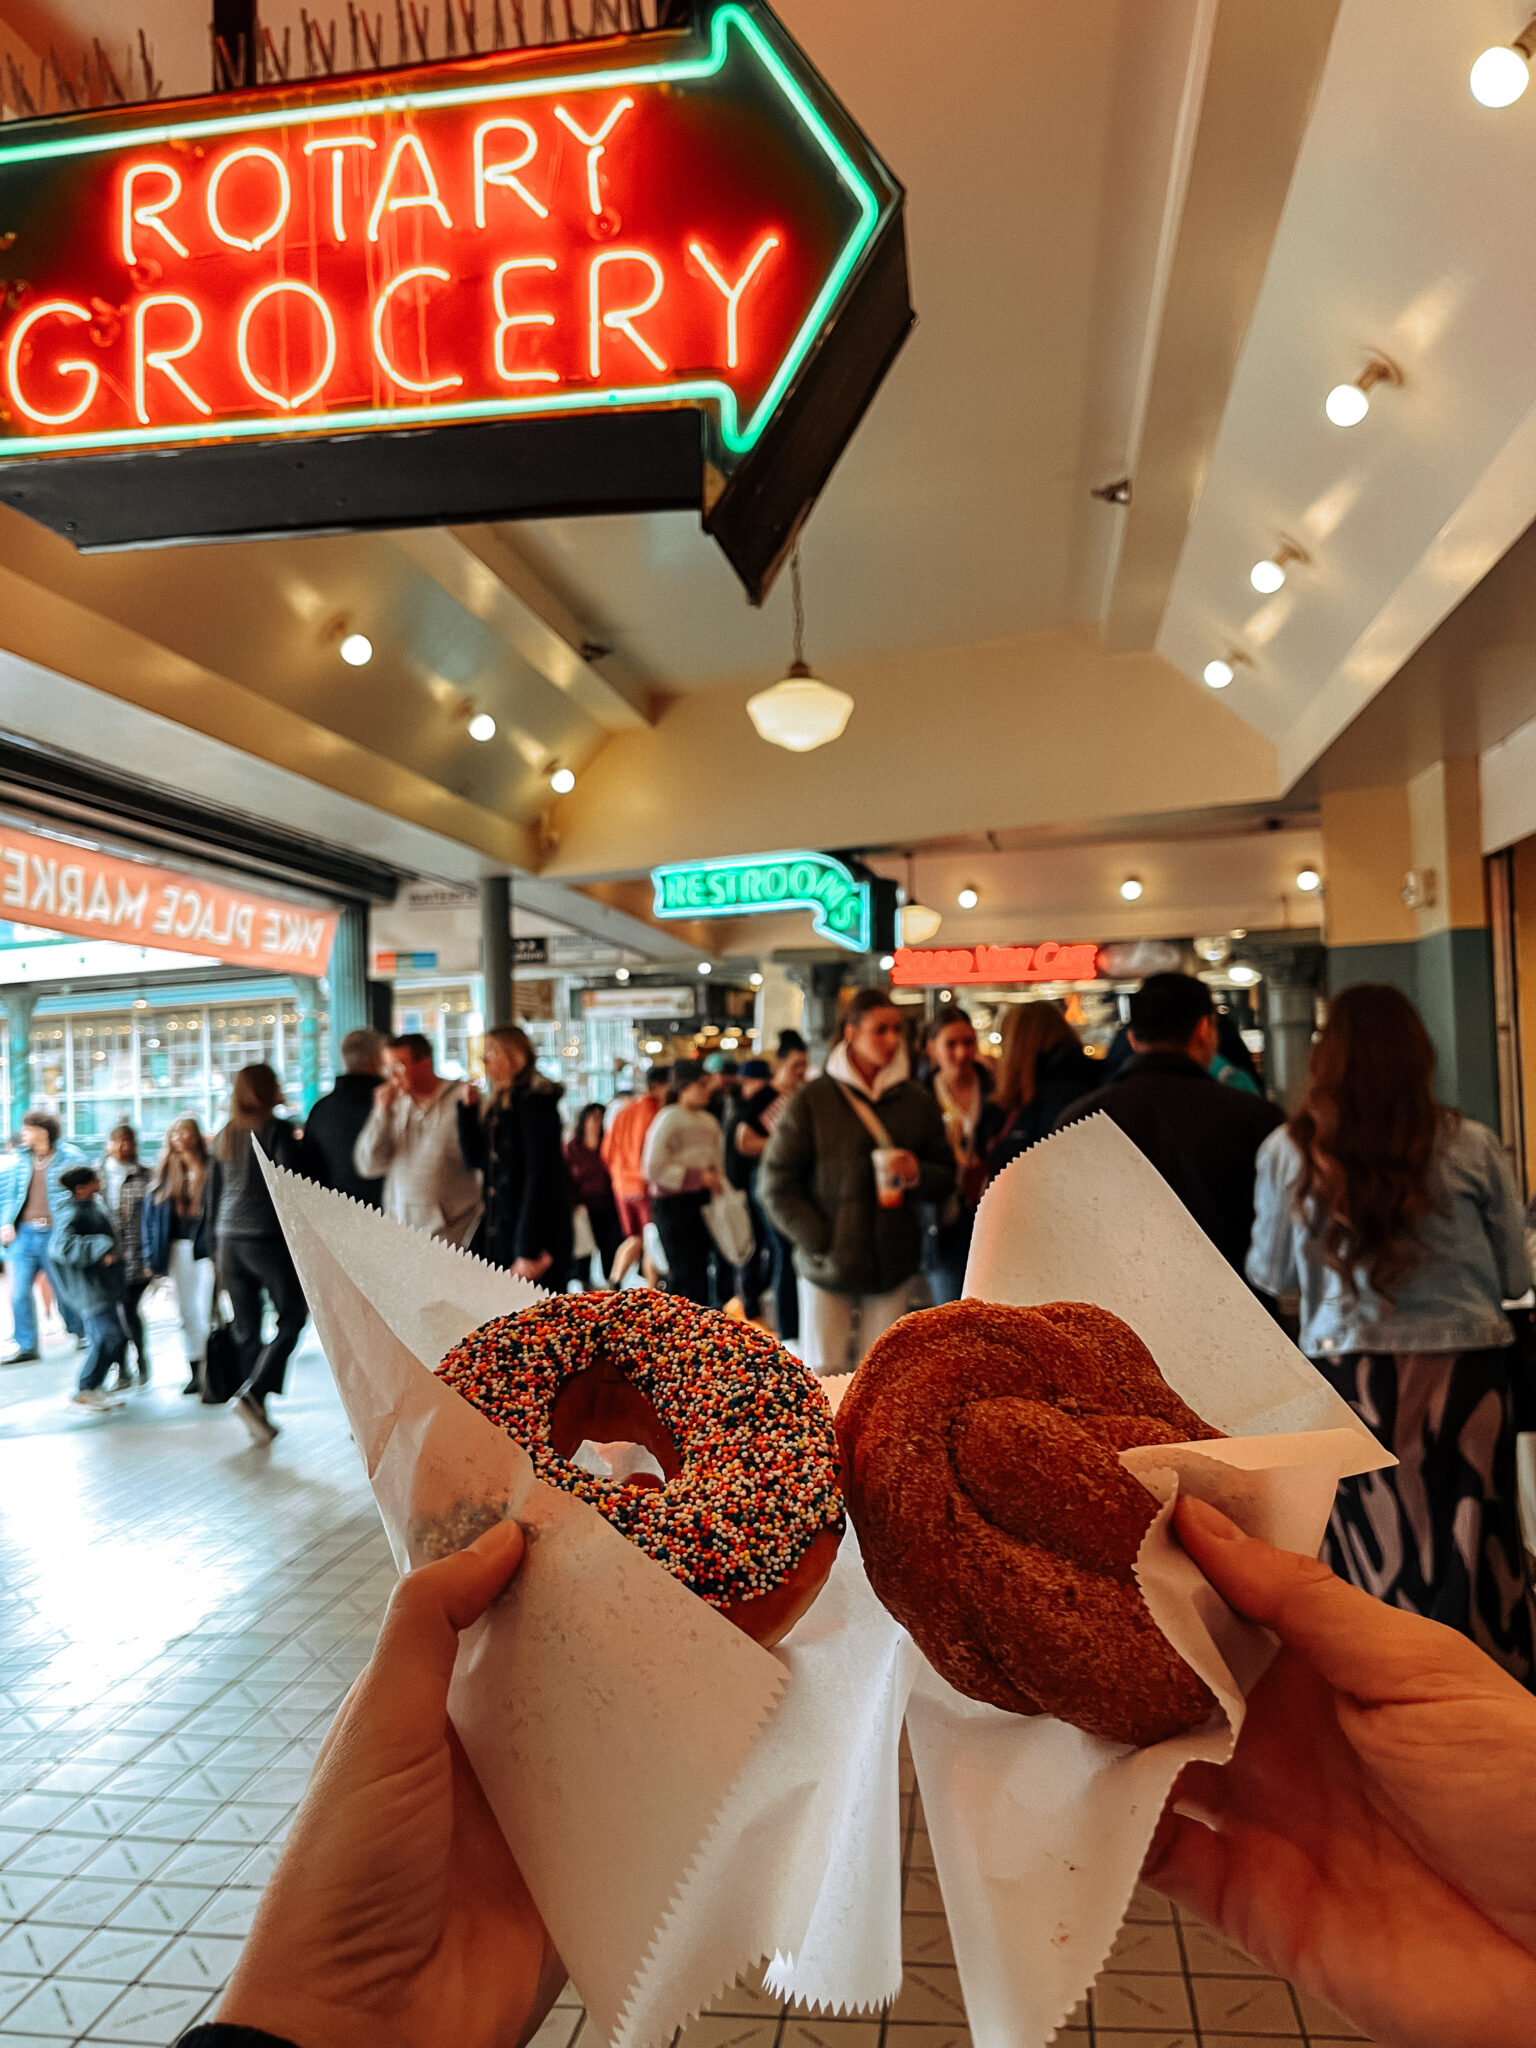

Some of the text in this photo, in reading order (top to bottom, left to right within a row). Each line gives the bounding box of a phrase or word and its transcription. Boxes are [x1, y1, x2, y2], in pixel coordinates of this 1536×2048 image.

[120, 97, 636, 267] ROTARY
[6, 236, 781, 427] GROCERY
[664, 861, 861, 931] RESTROOMS
